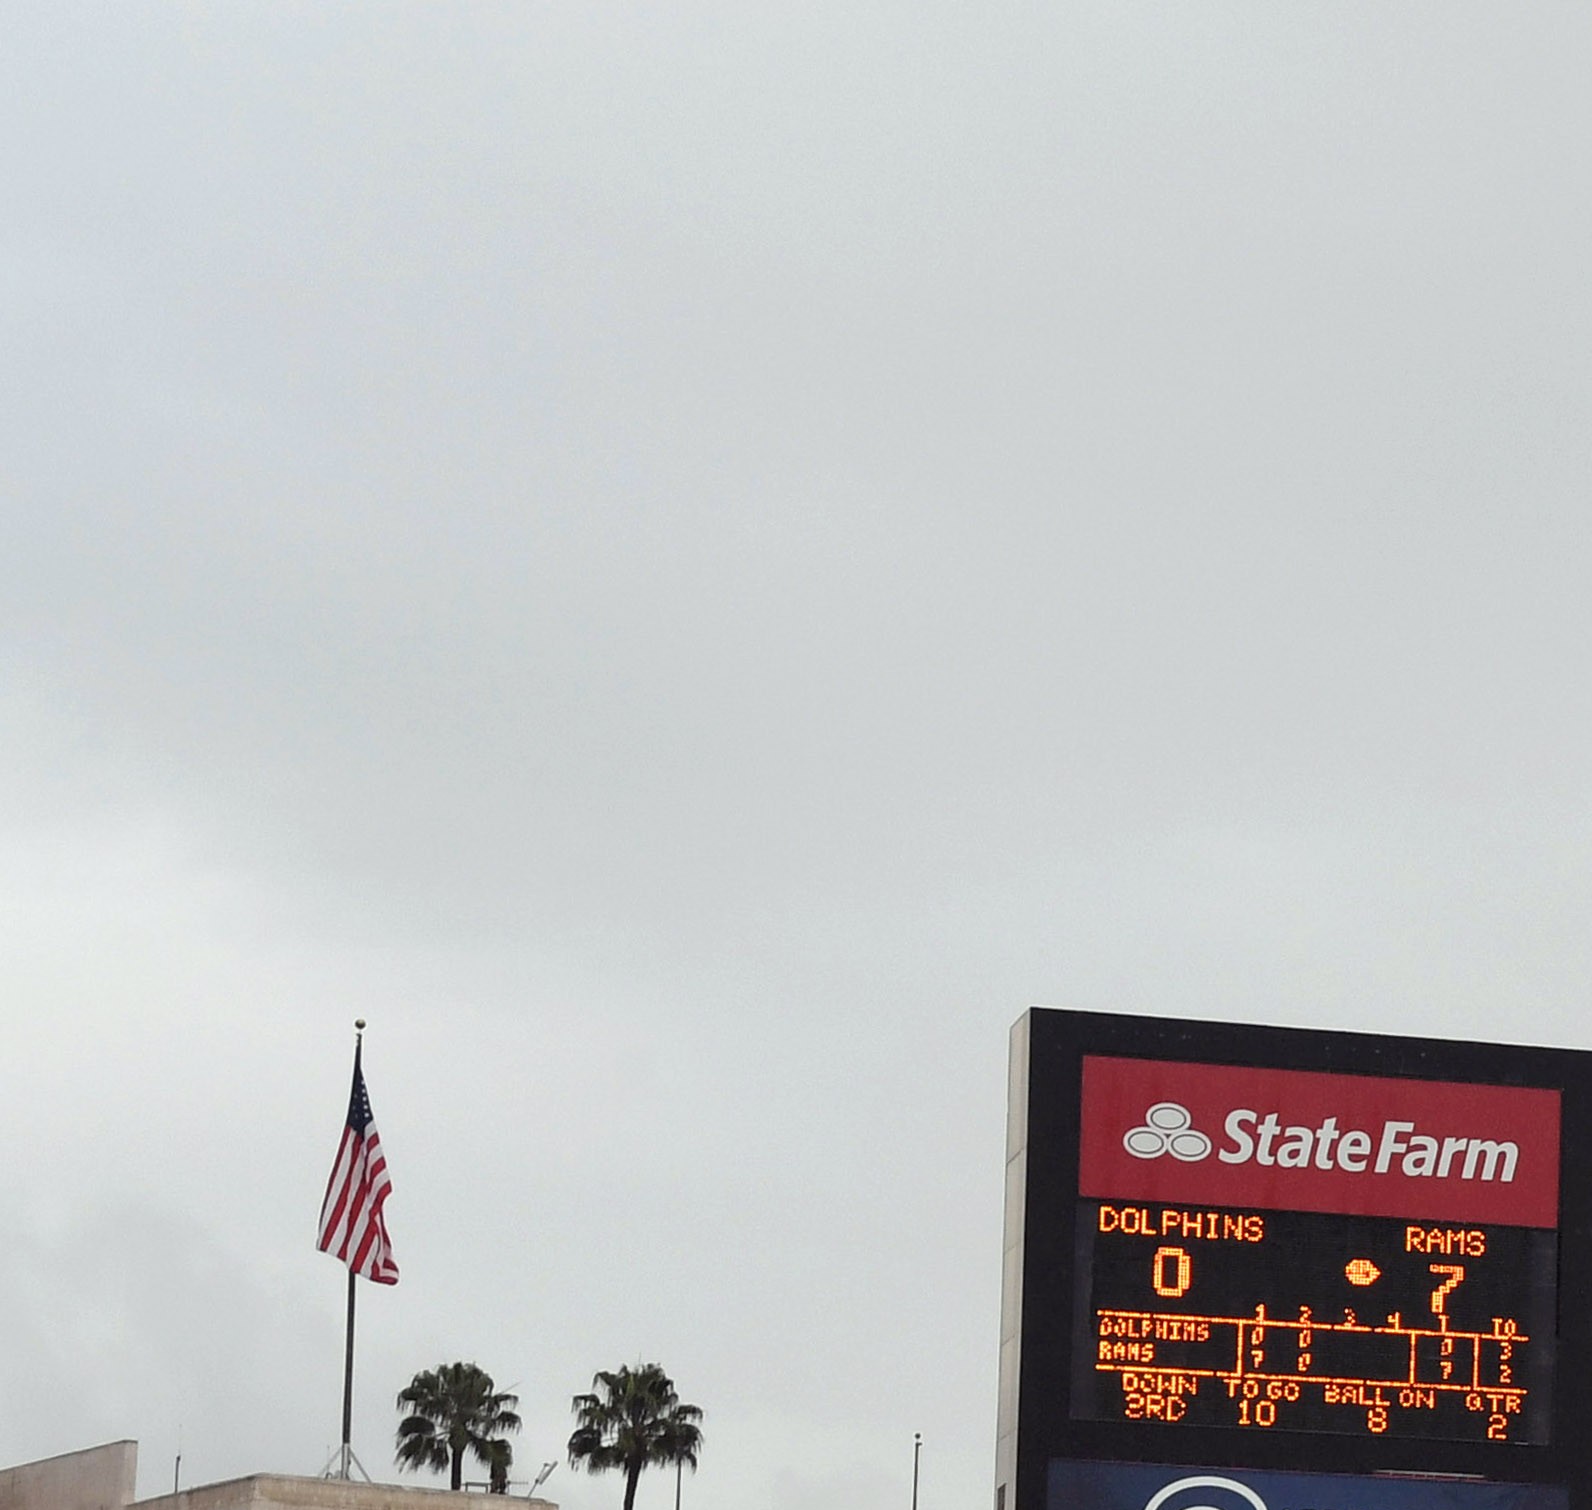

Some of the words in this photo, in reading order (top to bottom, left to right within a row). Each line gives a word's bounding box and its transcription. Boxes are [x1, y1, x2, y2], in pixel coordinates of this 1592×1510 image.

[1100, 1206, 1264, 1241] DOLPHINS
[1406, 1226, 1485, 1256] RAMS
[1153, 1247, 1191, 1297] 0
[1429, 1264, 1464, 1313] 7
[1100, 1318, 1210, 1341] DOLPHINS
[1099, 1341, 1154, 1362] RAMS
[1122, 1373, 1197, 1395] DOWN
[1223, 1379, 1259, 1398] TO
[1267, 1381, 1300, 1401] GO
[1325, 1384, 1391, 1407] BALL
[1399, 1389, 1435, 1409] ON
[1465, 1393, 1521, 1414] QTR
[1239, 1400, 1276, 1426] 10
[1368, 1407, 1388, 1433] 8
[1488, 1414, 1507, 1440] 2
